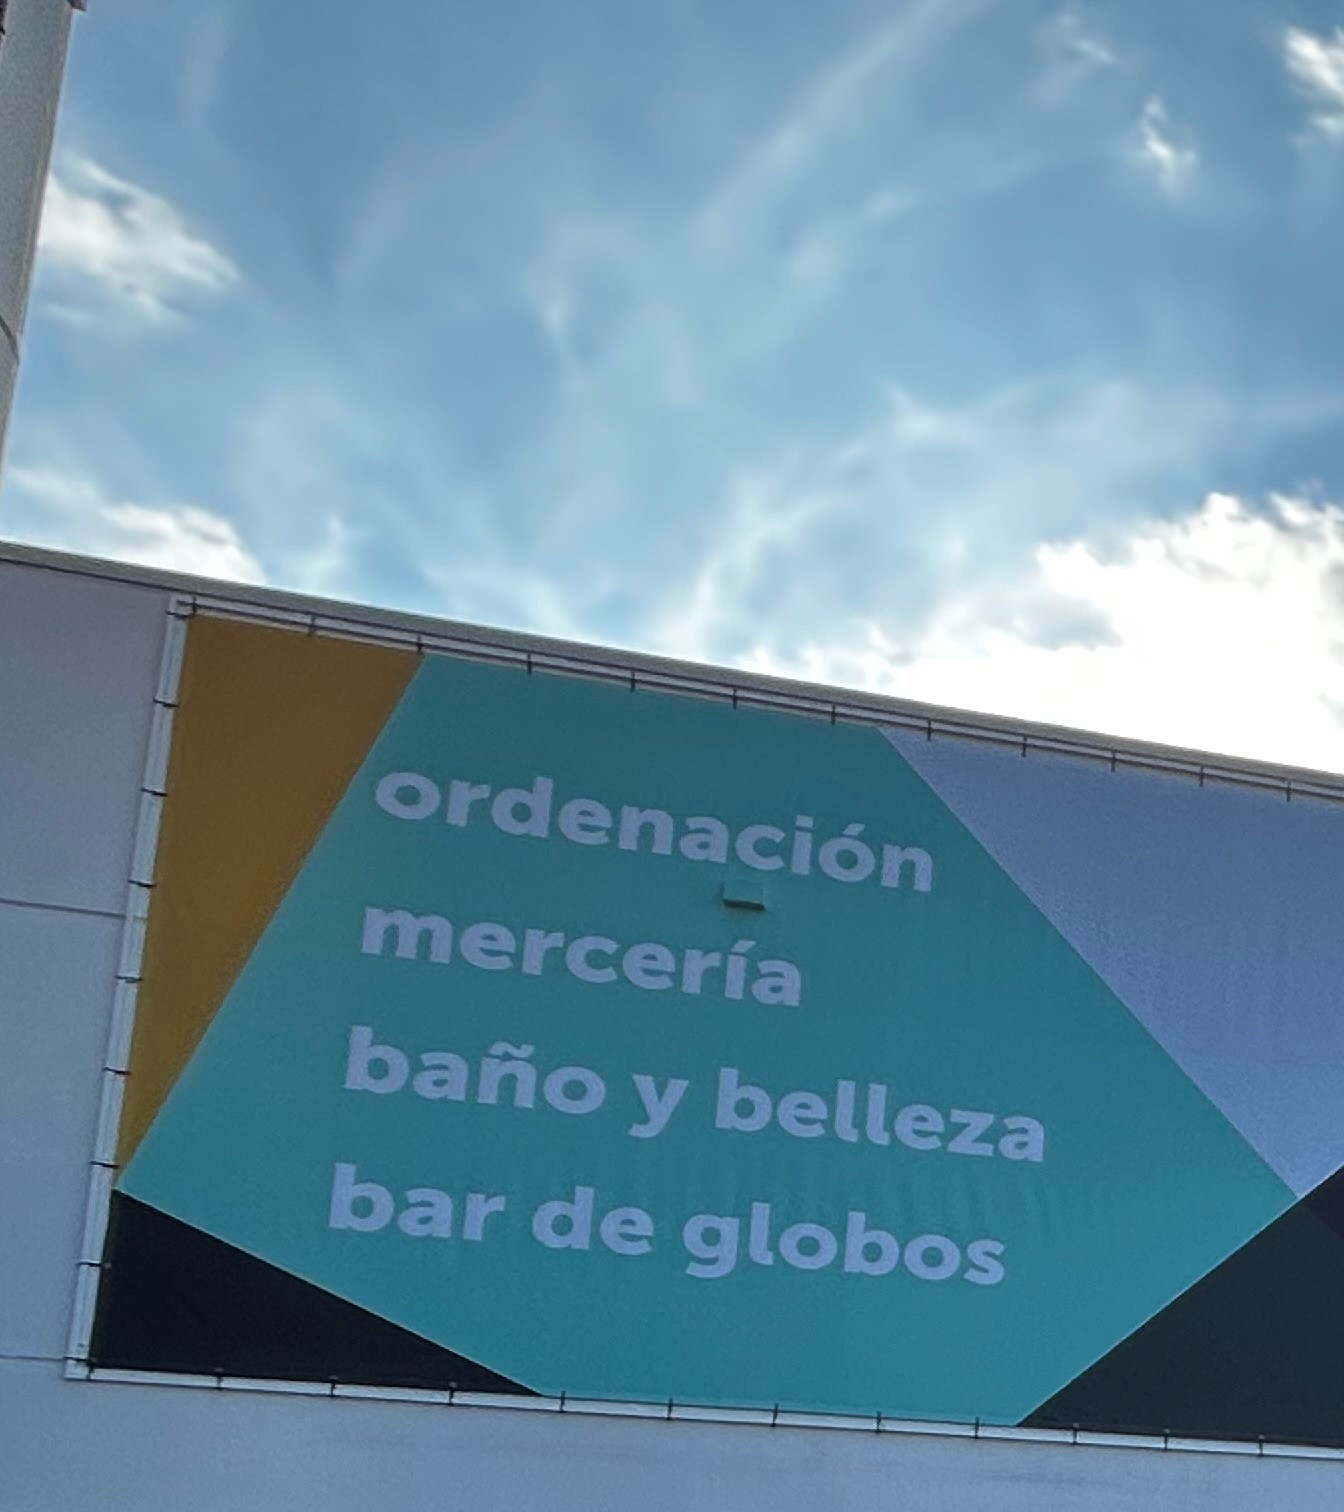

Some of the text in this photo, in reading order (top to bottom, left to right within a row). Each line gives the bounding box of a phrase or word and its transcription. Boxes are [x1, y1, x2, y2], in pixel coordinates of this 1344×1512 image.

[375, 771, 933, 892] ordenación
[360, 905, 801, 1007] mercería
[343, 1025, 1046, 1162] baño y belleza
[328, 1163, 1006, 1285] bar de globos
